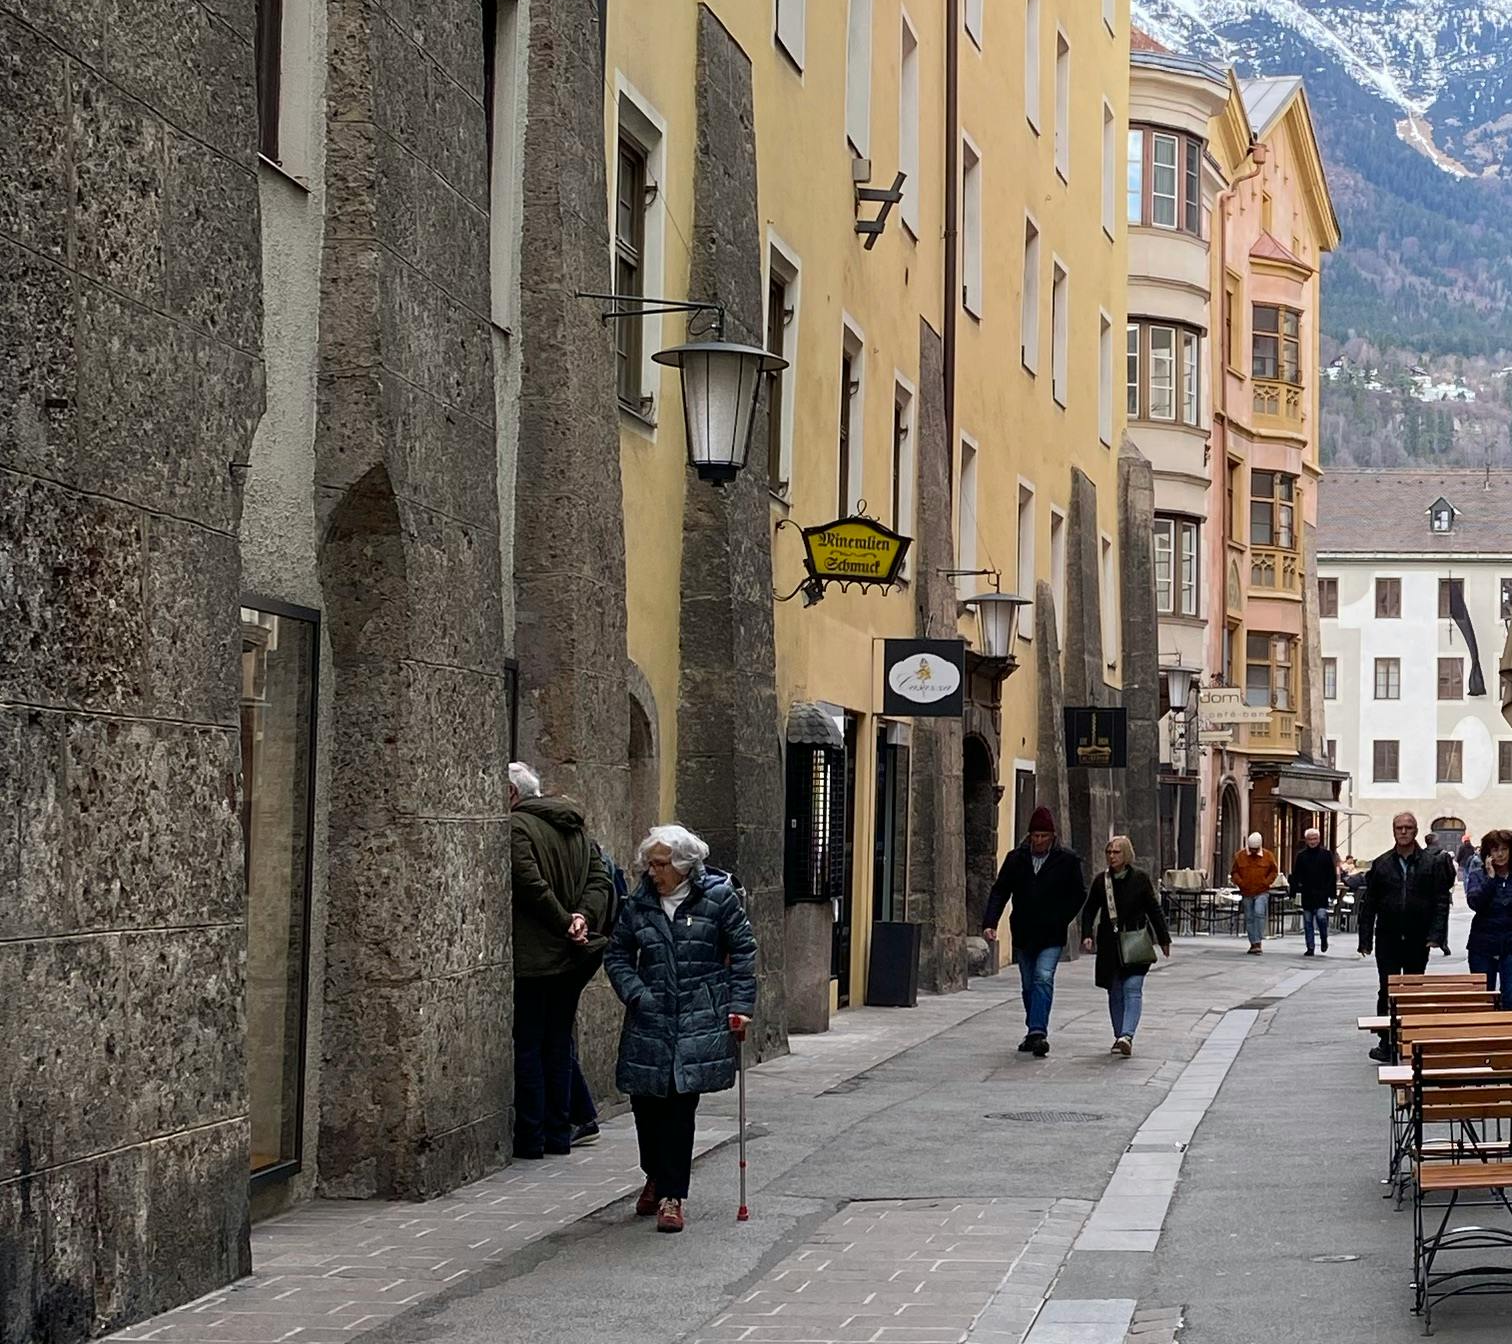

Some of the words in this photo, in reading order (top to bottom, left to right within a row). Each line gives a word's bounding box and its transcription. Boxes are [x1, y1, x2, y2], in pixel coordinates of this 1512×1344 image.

[818, 532, 890, 551] Mineralien
[824, 556, 881, 574] Schmuck
[1200, 692, 1240, 704] dom
